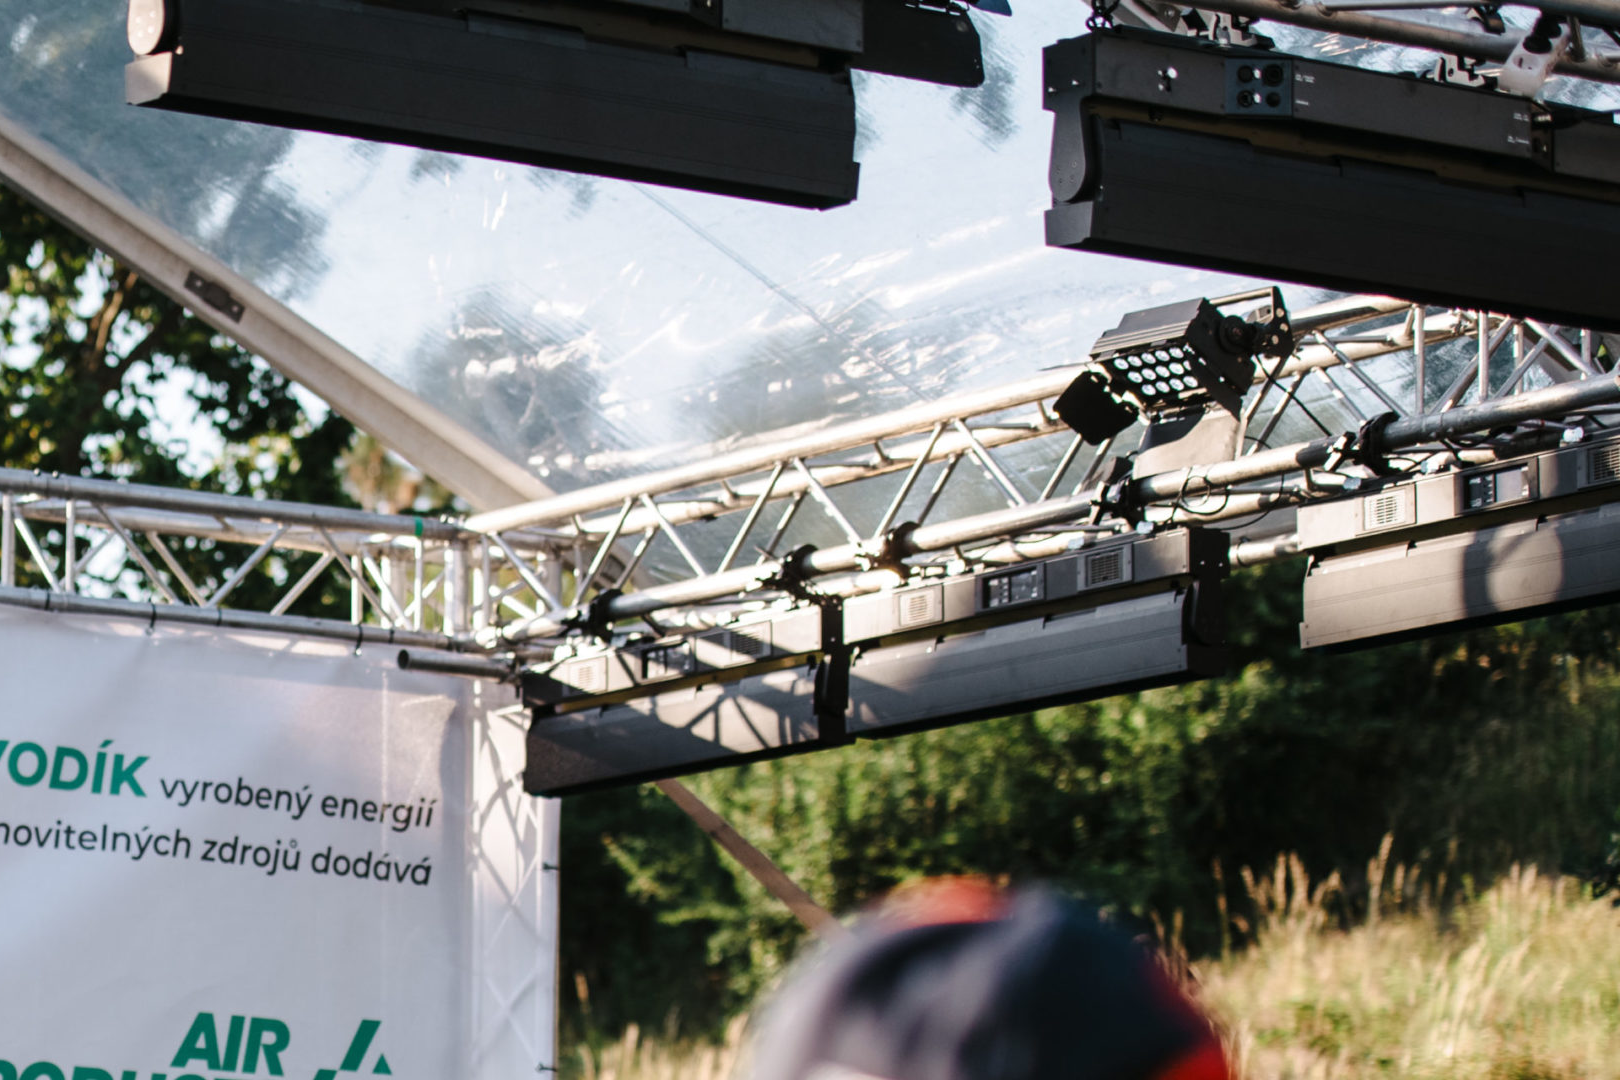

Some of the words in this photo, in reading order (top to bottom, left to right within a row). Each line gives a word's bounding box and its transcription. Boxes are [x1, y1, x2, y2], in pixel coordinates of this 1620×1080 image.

[159, 777, 313, 821] vyrobený
[320, 797, 438, 833] energií
[200, 836, 301, 877] zdrojů
[310, 846, 433, 886] dodává
[169, 1011, 291, 1077] AIR
